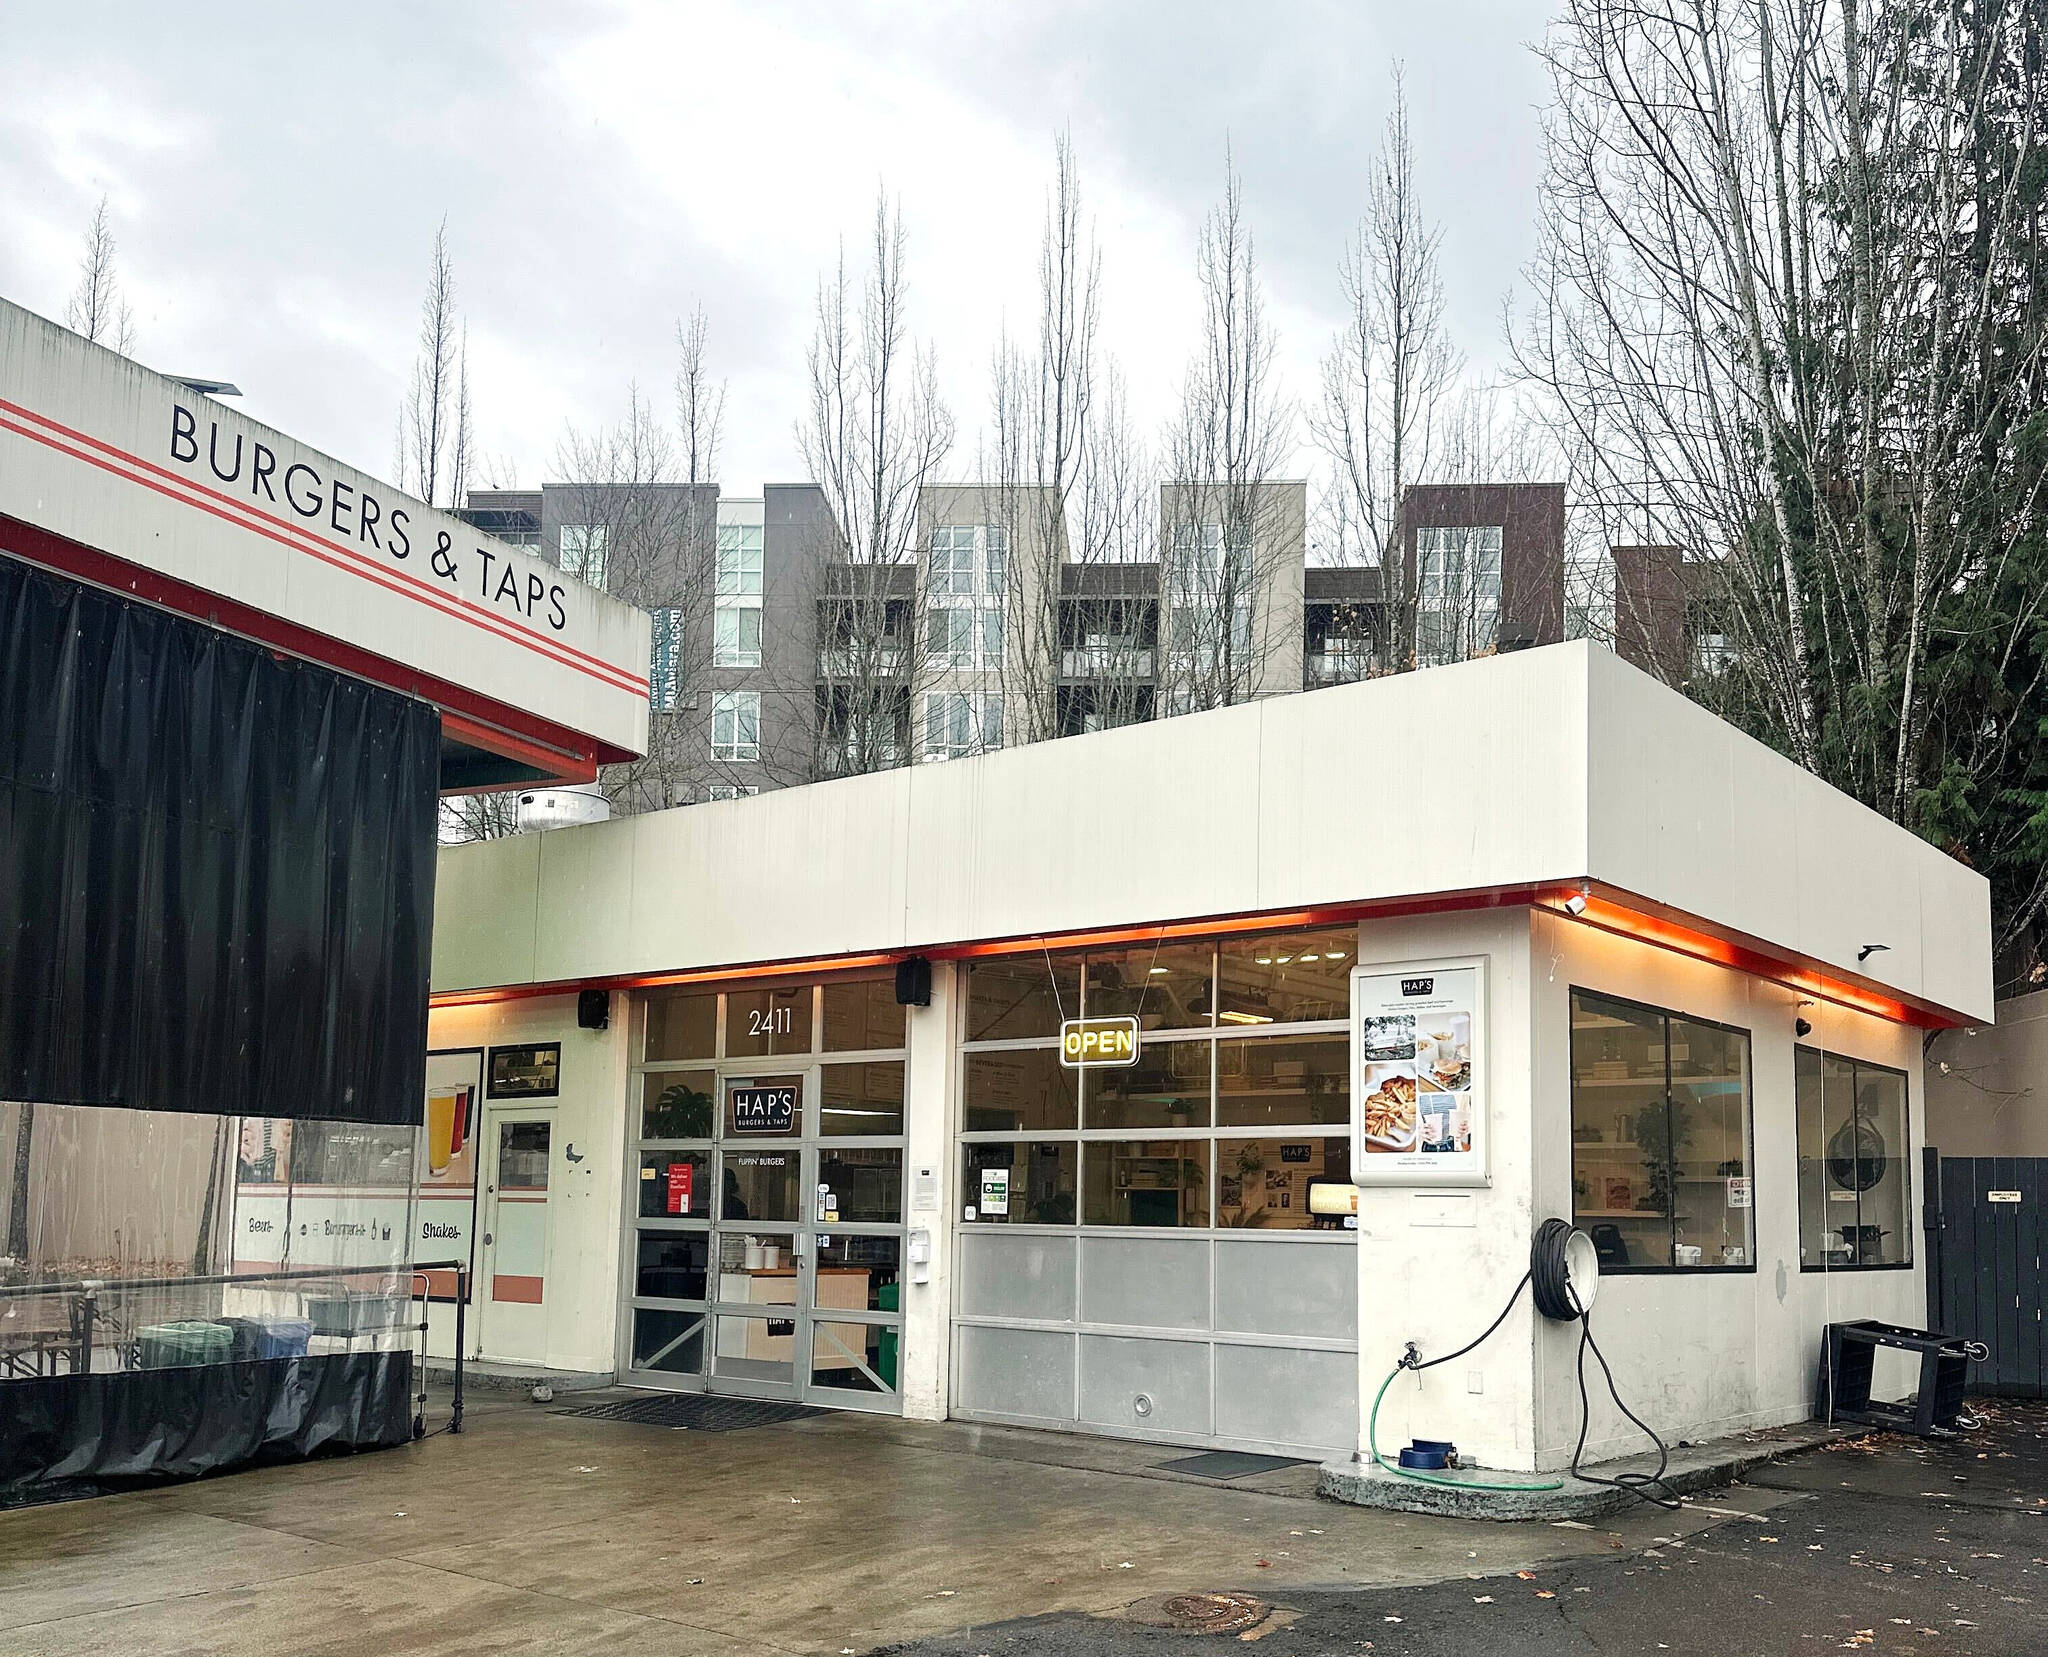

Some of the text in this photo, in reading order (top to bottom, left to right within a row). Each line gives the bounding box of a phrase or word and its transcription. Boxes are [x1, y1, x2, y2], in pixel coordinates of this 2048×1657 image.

[171, 404, 567, 631] BURGERS & TAPS
[1403, 980, 1432, 991] HAP'S
[748, 1007, 791, 1036] 2411
[1065, 1030, 1132, 1054] OPEN
[737, 1090, 792, 1116] HAP'S
[738, 1118, 765, 1126] BURGERS
[767, 1118, 771, 1126] &
[759, 1157, 785, 1166] BURGERS
[1282, 1147, 1310, 1158] HAP'S
[422, 1222, 462, 1240] Shakes
